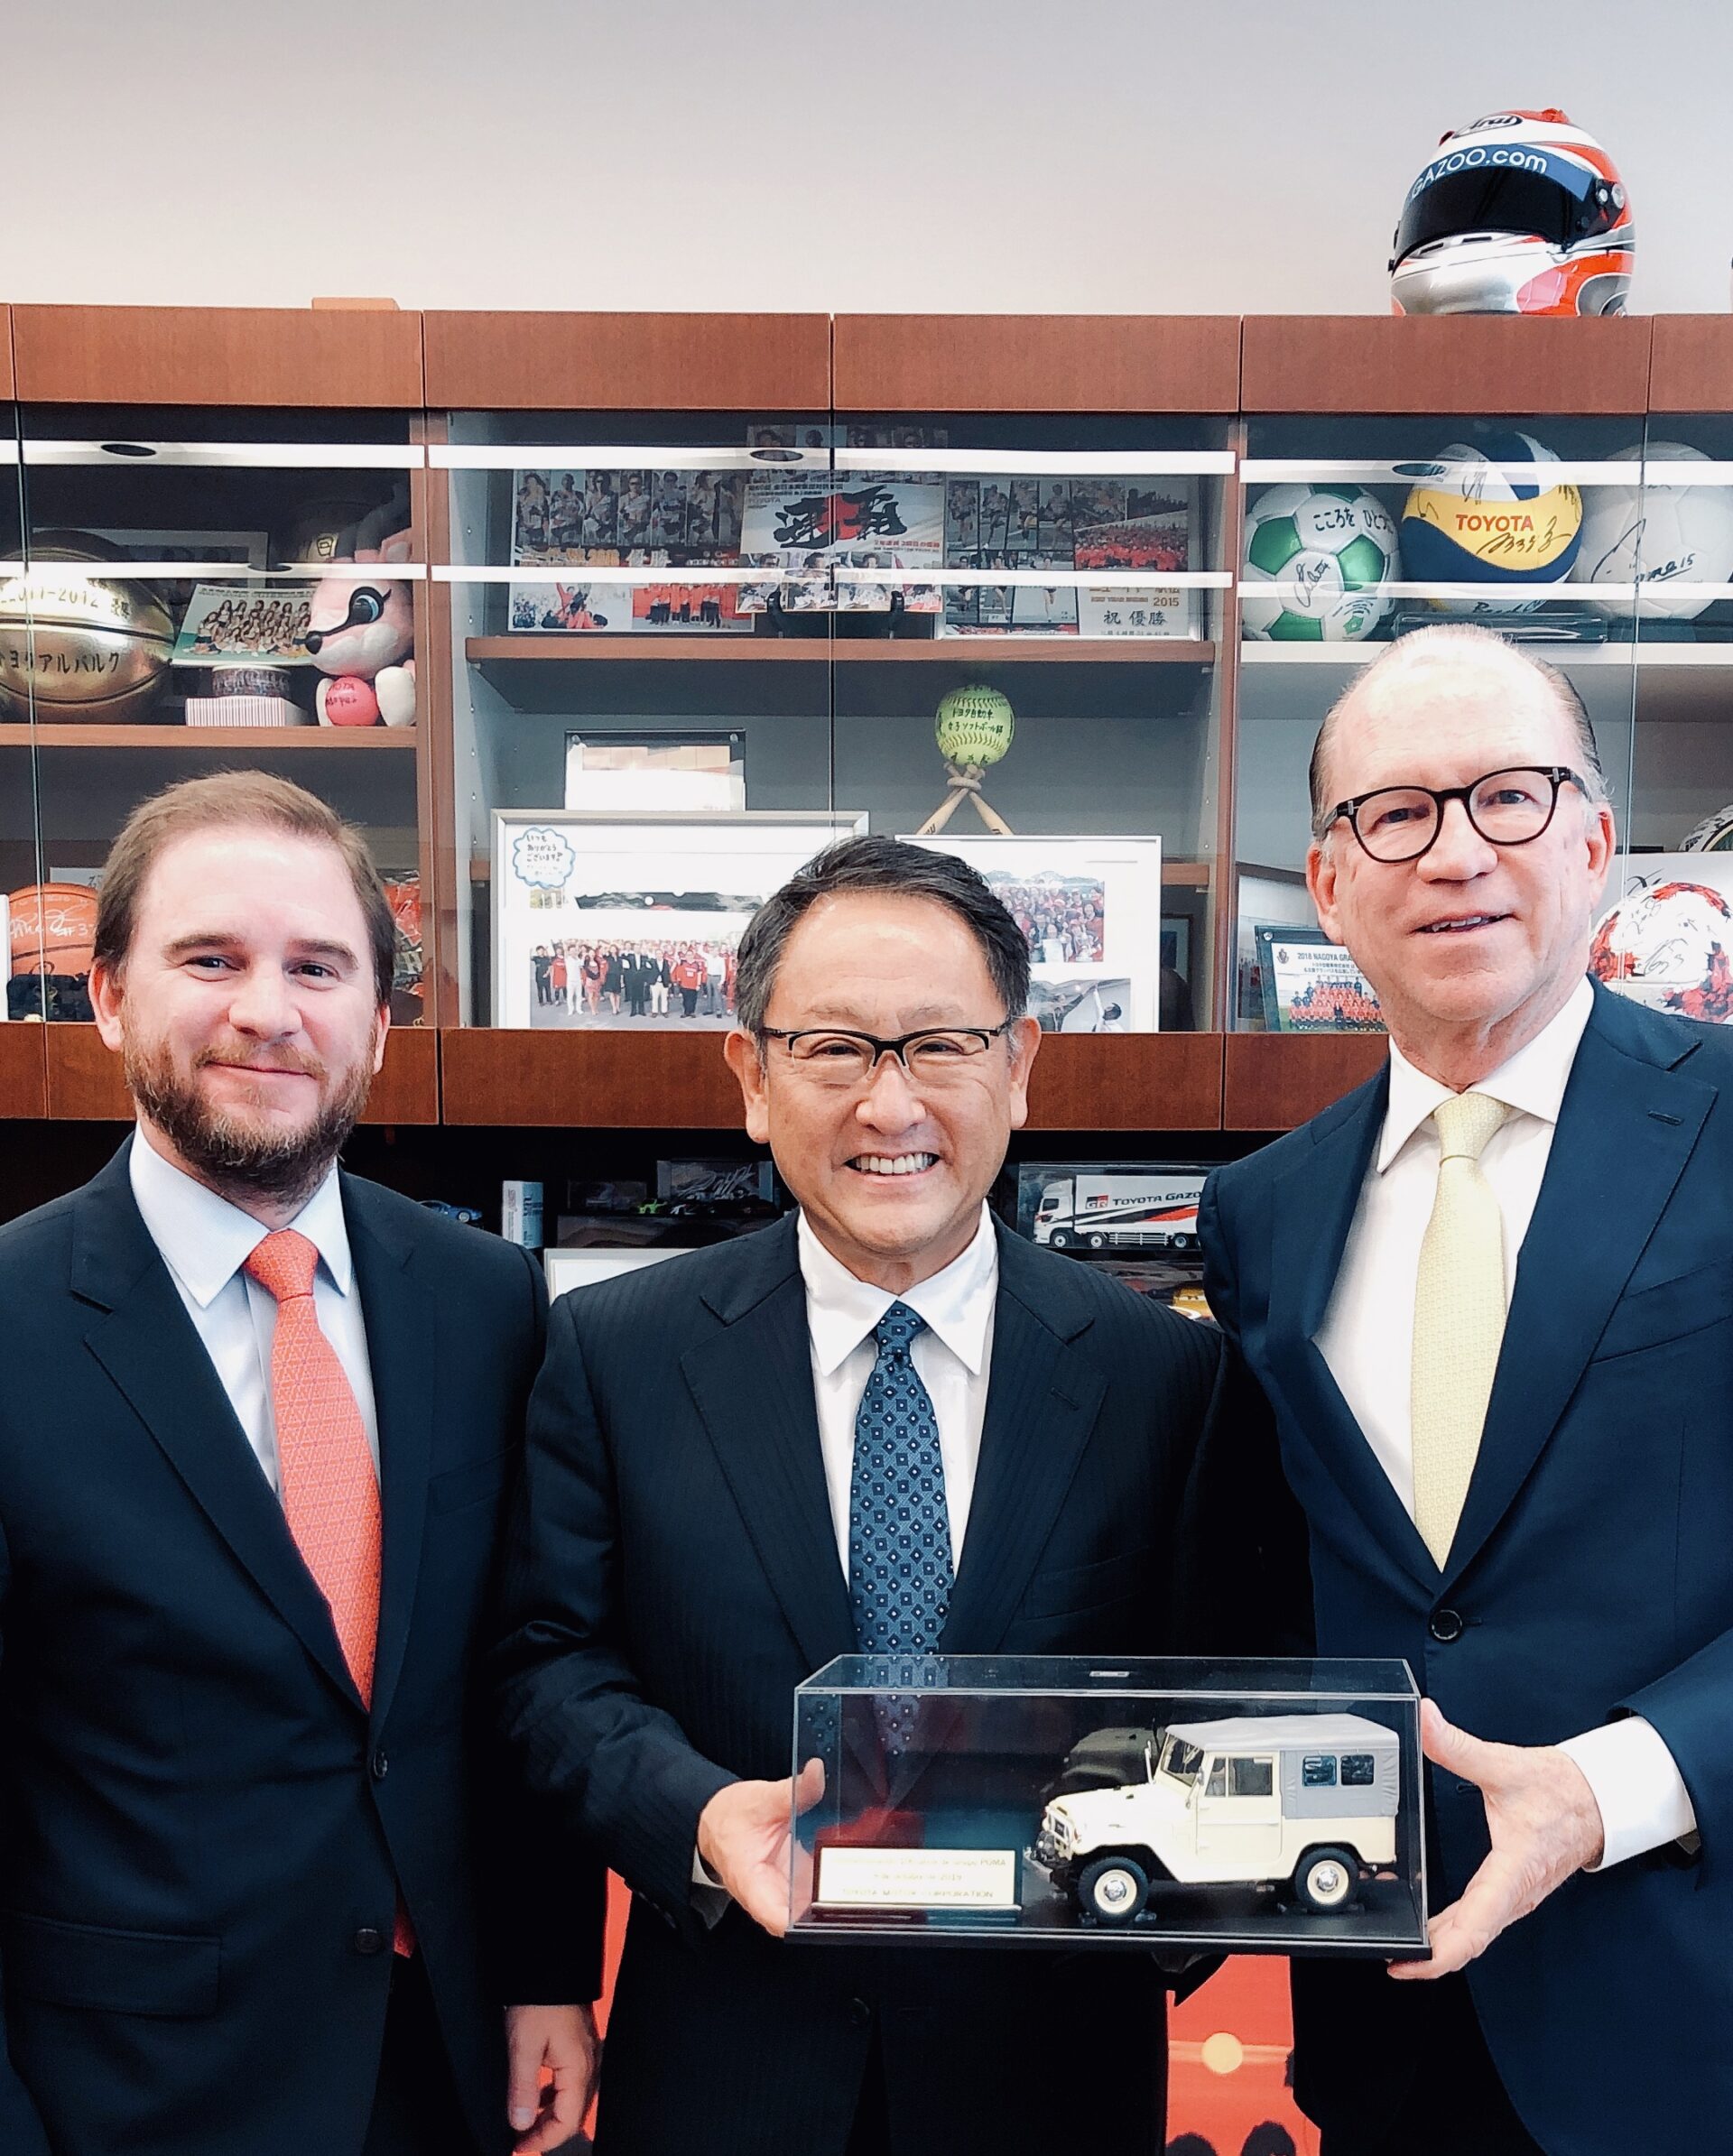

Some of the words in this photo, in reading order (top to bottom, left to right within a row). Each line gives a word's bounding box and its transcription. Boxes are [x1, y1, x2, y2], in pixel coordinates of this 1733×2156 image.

[1411, 148, 1547, 199] GAZOO.com
[1313, 507, 1356, 532] こころを
[1456, 514, 1534, 532] TOYOTA
[1153, 597, 1180, 607] 2015
[1103, 610, 1121, 625] 祝
[1129, 609, 1167, 625] 優勝
[1313, 953, 1338, 961] NAGOYA
[1113, 1195, 1162, 1206] TOYOTA
